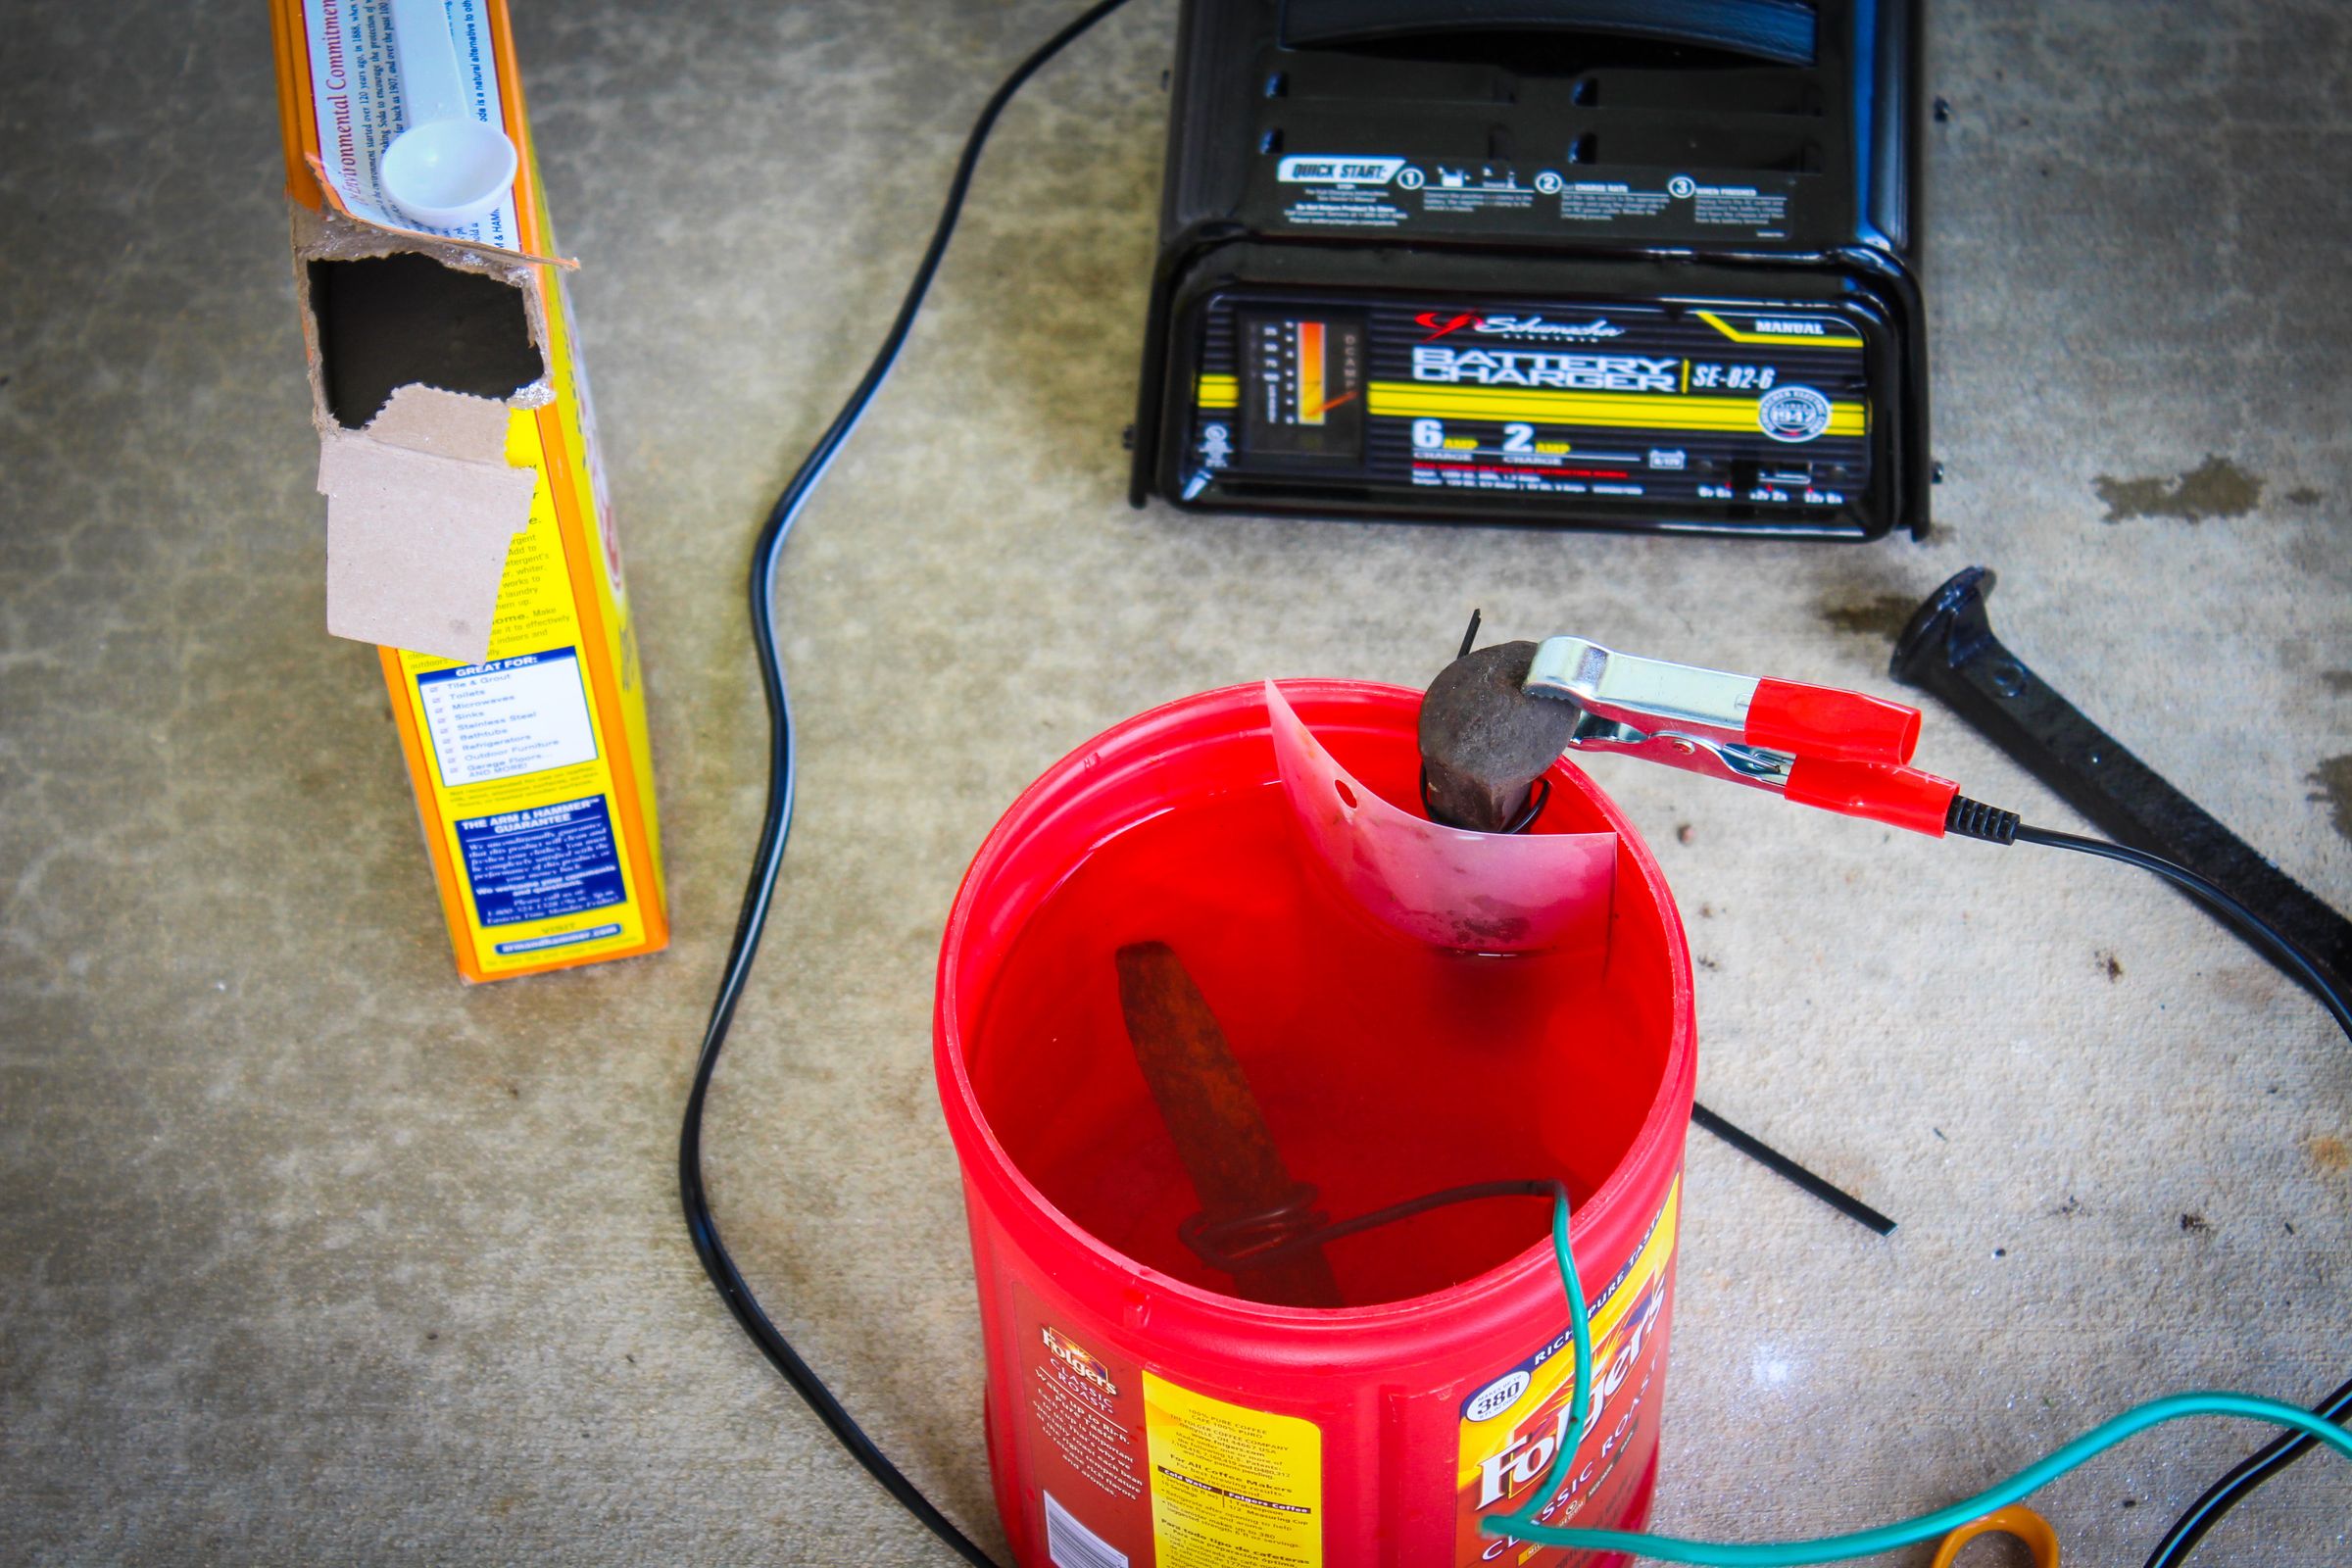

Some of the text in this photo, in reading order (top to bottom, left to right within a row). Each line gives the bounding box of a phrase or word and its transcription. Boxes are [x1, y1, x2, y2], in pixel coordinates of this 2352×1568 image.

[366, 16, 380, 48] protection
[382, 32, 392, 42] the
[466, 24, 479, 62] alternative
[369, 51, 380, 62] the
[385, 61, 396, 74] and
[470, 64, 482, 90] natural
[359, 71, 369, 89] years
[373, 65, 384, 98] encourage
[359, 91, 369, 104] 120
[363, 107, 371, 122] over
[376, 111, 387, 127] Soda
[326, 95, 361, 194] Environmental
[362, 123, 374, 147] started
[1293, 164, 1335, 178] QUICK
[1474, 316, 1626, 337] Schumacher
[1755, 320, 1824, 334] MANUAL
[1412, 346, 1679, 374] BATTERY
[1412, 364, 1676, 392] CHARGER
[1412, 418, 1479, 450] 6 AMP
[1502, 423, 1571, 454] 2 AMP
[1413, 452, 1474, 462] CHARGE
[1502, 456, 1563, 466] CHARGE
[503, 578, 529, 588] works
[506, 587, 538, 599] laundry
[525, 614, 570, 629] effectively
[533, 608, 557, 617] Make
[497, 629, 548, 645] indoors and
[456, 656, 538, 676] GREAT FOR:
[448, 681, 466, 690] Tile
[480, 674, 511, 684] Grout
[450, 689, 485, 700] Toilets
[452, 695, 515, 710] Microwaves
[455, 710, 484, 720] Sinks
[457, 711, 537, 730] Stainless Steel
[460, 728, 508, 741] Bathtubs
[463, 735, 531, 751] Refrigerators
[465, 739, 559, 761] Outdoor Furniture
[466, 760, 506, 772] Garage
[494, 762, 527, 774] MORE!
[462, 818, 487, 830] THE
[490, 813, 518, 826] ARM
[521, 811, 530, 820] &
[494, 813, 571, 833] GUARANTEE
[1587, 1271, 1624, 1319] PURE
[1042, 1328, 1116, 1396] Folgers
[1051, 1358, 1113, 1408] CLASSIC
[1036, 1369, 1066, 1400] Wake
[1070, 1400, 1085, 1414] up
[1088, 1414, 1100, 1424] to
[1478, 1382, 1520, 1414] 380
[1055, 1395, 1114, 1443] Pure Taste
[1235, 1423, 1267, 1435] COFFEE
[1059, 1409, 1076, 1424] cup
[1089, 1431, 1134, 1463] important
[1215, 1428, 1243, 1440] COFFEE
[1246, 1438, 1289, 1451] COMPANY
[1062, 1454, 1079, 1470] and
[1062, 1438, 1084, 1456] right
[1086, 1455, 1141, 1493] temperature
[1072, 1437, 1096, 1456] roast
[1098, 1455, 1118, 1472] each
[1120, 1469, 1143, 1486] bean
[1098, 1446, 1116, 1461] why
[1117, 1459, 1131, 1470] we
[1087, 1465, 1103, 1480] rich
[1105, 1478, 1136, 1500] flavors
[1164, 1469, 1183, 1481] Cold
[1185, 1477, 1212, 1492] Water
[1170, 1453, 1293, 1494] For All Coffee Makers
[1229, 1492, 1269, 1506] Folgers
[1272, 1502, 1308, 1514] Coffee
[1483, 1460, 1594, 1560] CLSSIC
[1161, 1518, 1181, 1531] Para
[1184, 1527, 1207, 1541] todo
[1210, 1537, 1232, 1549] tipo
[1253, 1550, 1310, 1565] cafeteras
